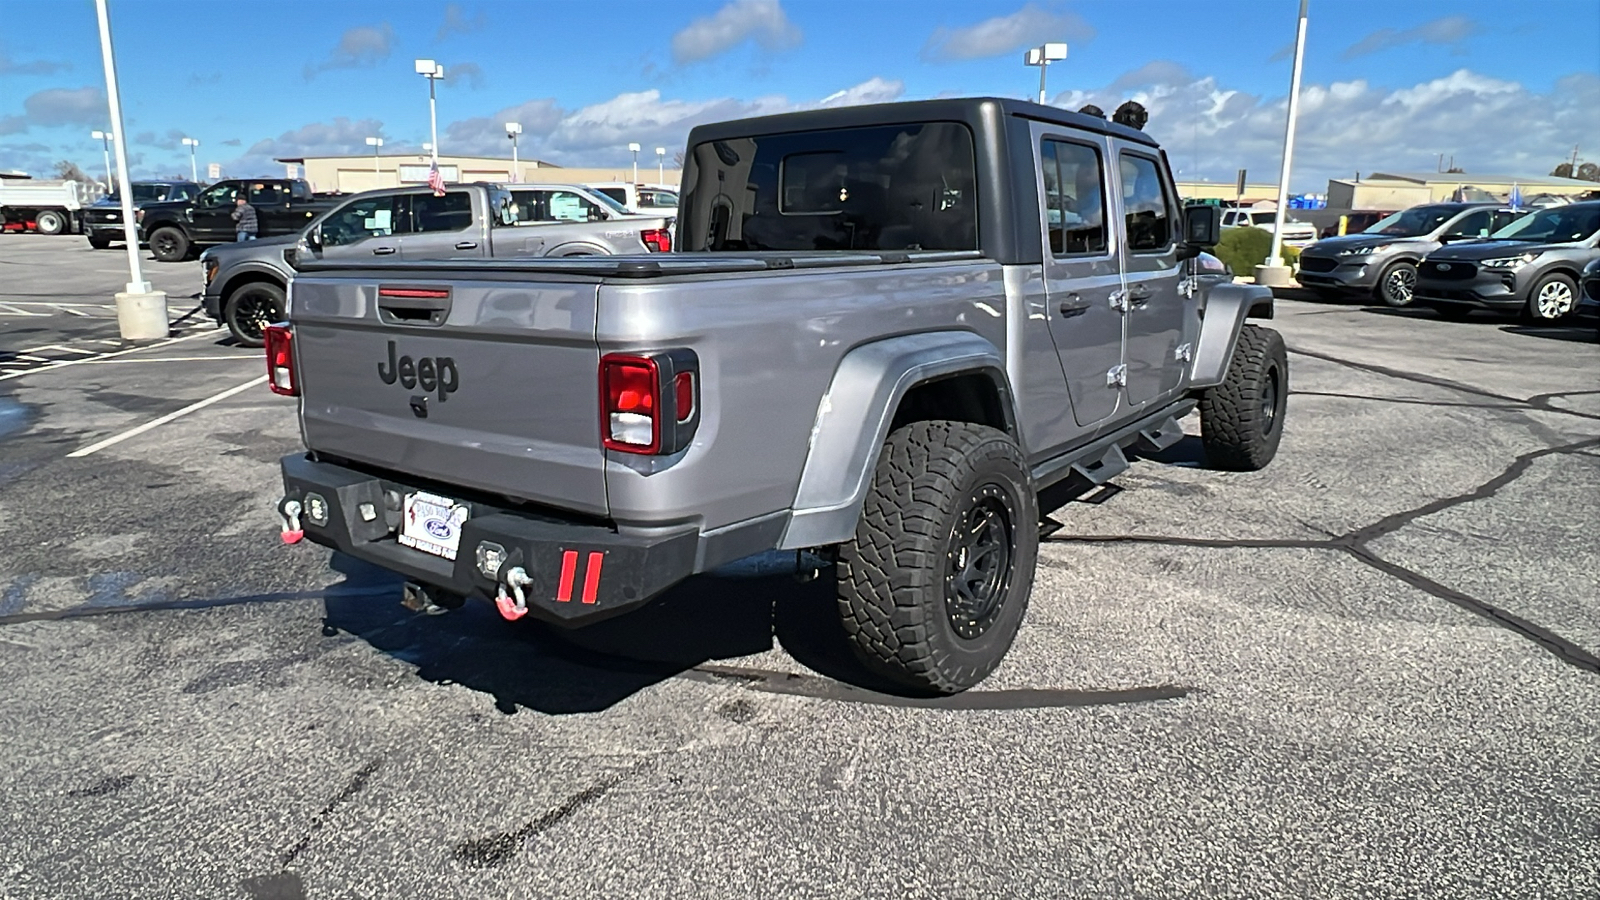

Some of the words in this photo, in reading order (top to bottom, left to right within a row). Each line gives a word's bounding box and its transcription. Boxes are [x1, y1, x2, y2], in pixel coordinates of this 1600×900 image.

[378, 341, 459, 403] Jeep
[416, 502, 434, 517] PASO
[427, 520, 450, 537] Ford
